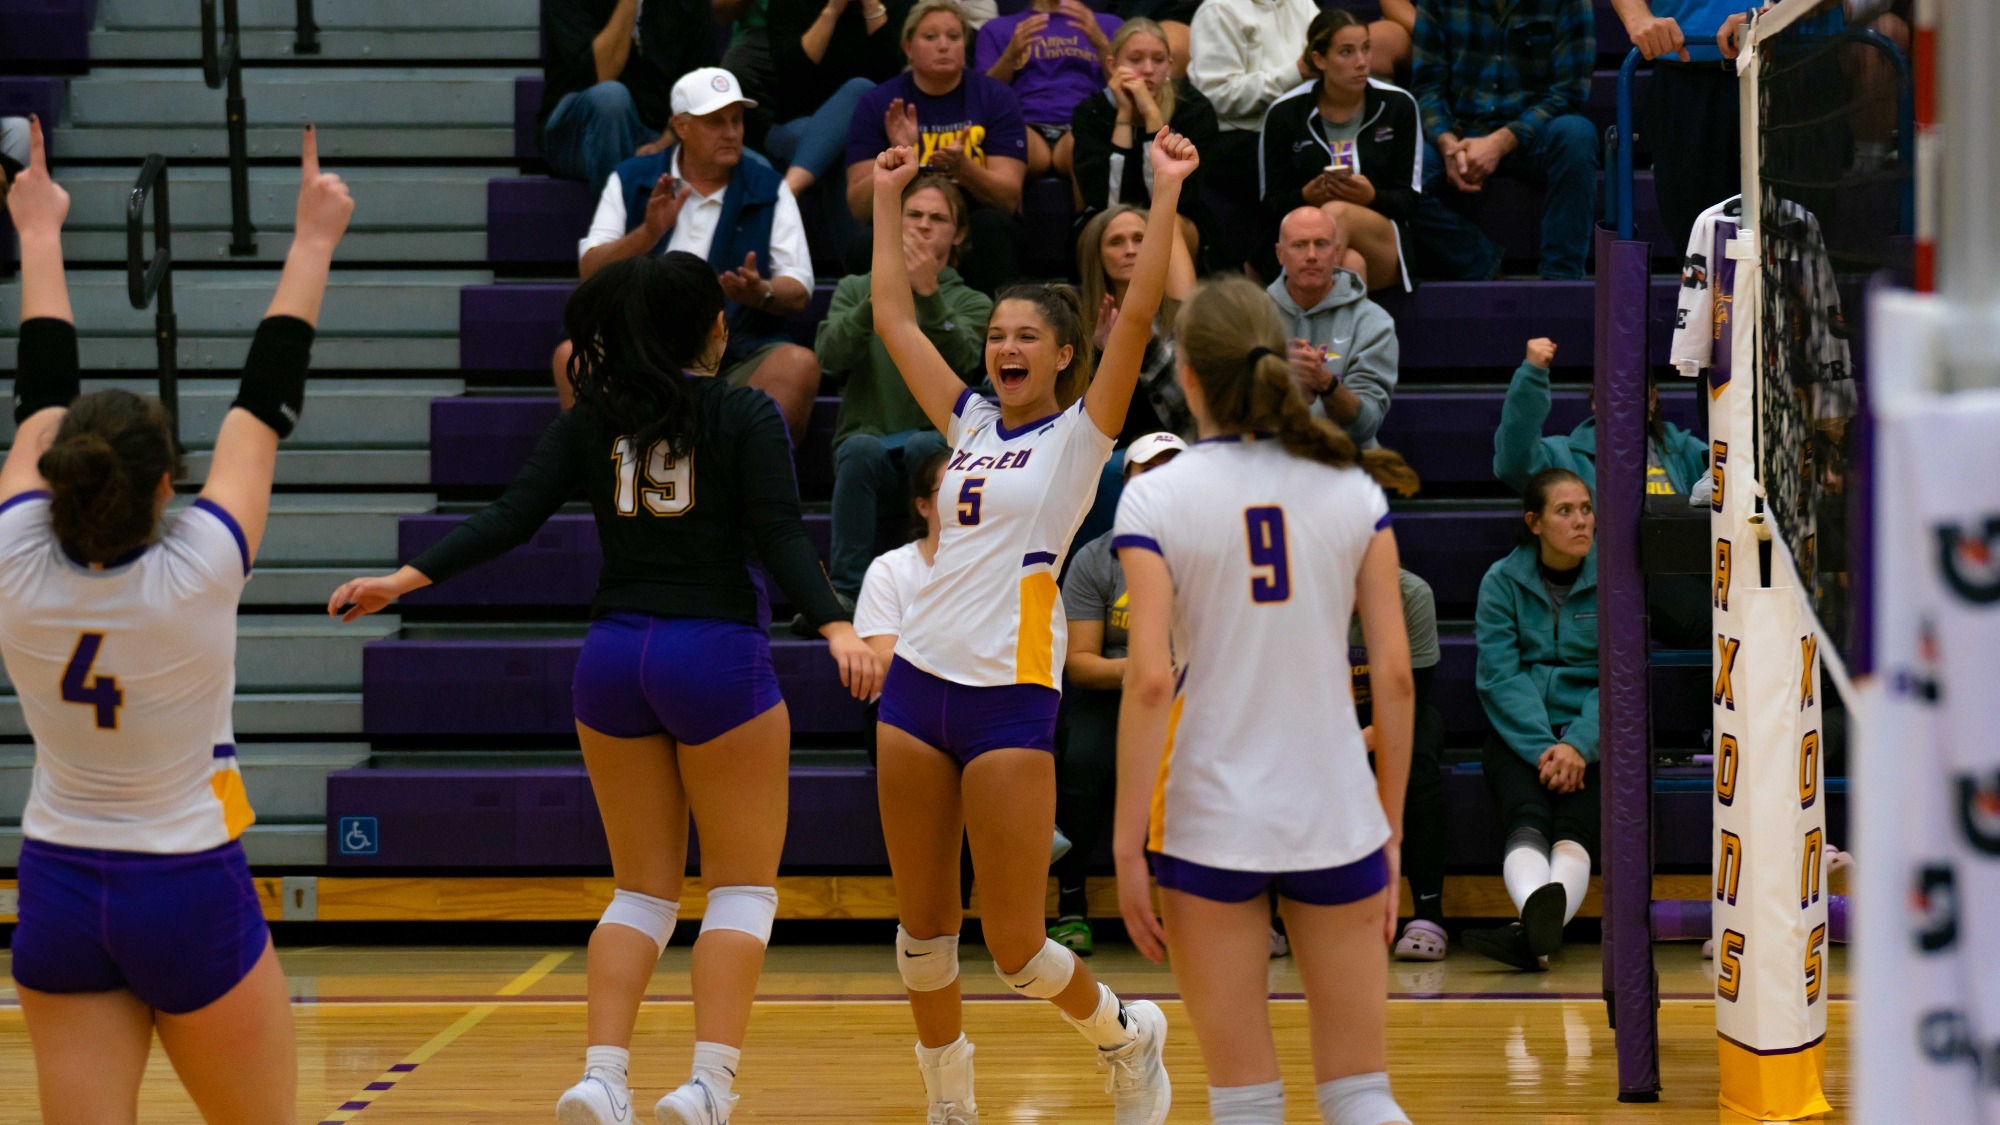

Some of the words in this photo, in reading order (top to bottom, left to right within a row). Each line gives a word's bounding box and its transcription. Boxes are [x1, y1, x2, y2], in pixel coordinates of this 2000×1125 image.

[610, 434, 695, 517] 19
[956, 476, 987, 527] 5
[1242, 504, 1292, 606] 9
[59, 629, 125, 731] 4
[1709, 440, 1745, 1004] SAXONS
